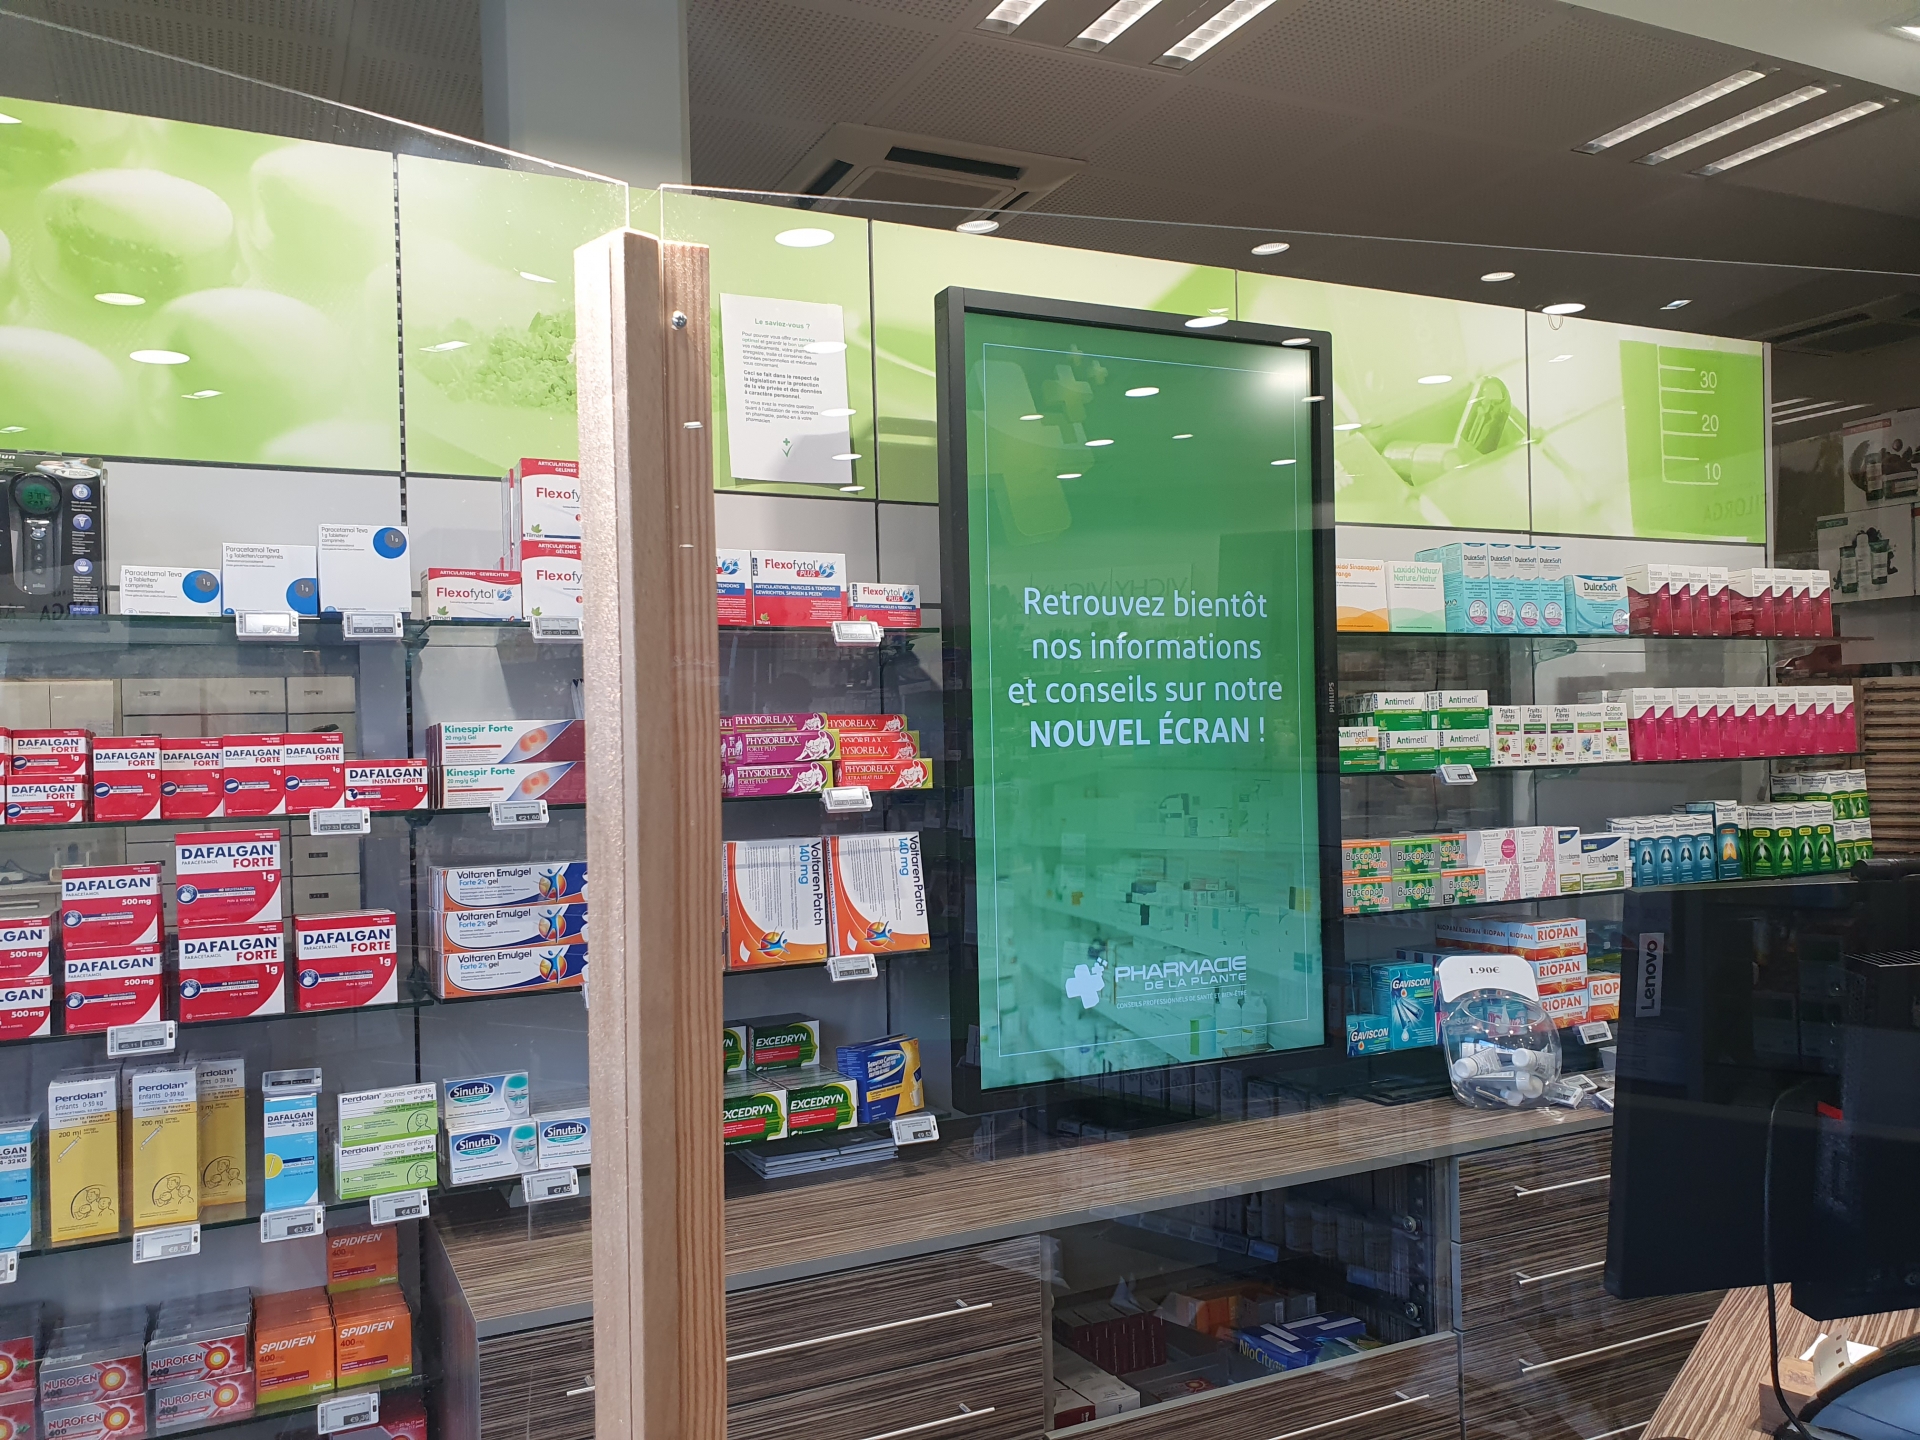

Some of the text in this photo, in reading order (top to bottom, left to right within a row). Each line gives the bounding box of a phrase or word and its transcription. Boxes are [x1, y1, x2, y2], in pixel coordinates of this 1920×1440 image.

[764, 320, 805, 330] saviez-vous
[1700, 371, 1717, 389] 30
[1702, 414, 1719, 432] 20
[1704, 463, 1721, 481] 10
[225, 546, 266, 554] Paracetamol
[765, 558, 816, 573] Flexofytol
[124, 569, 167, 578] Paracetamol
[862, 587, 900, 597] Flexofytol
[1584, 582, 1618, 592] DulceSoft
[436, 587, 494, 600] Flexofytol
[1024, 587, 1268, 618] Retrouvez bientôt
[1032, 631, 1262, 660] nos informations
[1008, 674, 1283, 704] et conseils sur notre
[1384, 697, 1415, 706] Antimetil
[1448, 694, 1478, 704] Antimetil
[736, 716, 794, 725] PHYSIORELAX
[444, 724, 514, 736] Kinespir Forte
[1030, 710, 1266, 748] NOUVEL ÉCRAN !
[18, 738, 79, 747] DAFALGAN
[746, 736, 800, 745] PHYSIORELAX
[1397, 736, 1428, 744] Antimetil
[1450, 734, 1480, 743] Antimetil
[95, 752, 156, 760] DAFALGAN
[225, 749, 280, 758] DAFALGAN
[128, 759, 156, 767] FORTE
[845, 764, 895, 774] PHYSIORELAX
[350, 768, 423, 778] DAFALGAN
[446, 768, 516, 780] Kinespir Forte
[738, 768, 792, 777] PHYSIORELAX
[181, 844, 274, 860] DAFALGAN
[898, 837, 908, 876] 140 mg
[1346, 852, 1382, 862] Buscopan
[1397, 852, 1435, 863] Buscopan
[234, 857, 274, 868] FORTE
[798, 844, 810, 884] 140 mg
[262, 872, 274, 882] 1g
[457, 868, 532, 880] Voltaren Emulgel
[909, 835, 926, 916] Voltaren Patch
[65, 877, 151, 892] DAFALGAN
[488, 878, 498, 887] gel
[810, 842, 824, 926] Voltaren Patch
[1449, 880, 1480, 890] Buscopan
[1346, 888, 1384, 900] Buscopan
[1398, 886, 1435, 899] Buscopan
[456, 908, 531, 920] Voltaren Emulgel
[1459, 926, 1481, 934] RIOPAN
[1484, 928, 1506, 938] RIOPAN
[1510, 932, 1533, 940] RIOPAN
[1538, 926, 1578, 941] RIOPAN
[304, 928, 390, 946] DAFALGAN
[184, 937, 278, 954] DAFALGAN
[351, 942, 390, 953] FORTE
[236, 950, 278, 962] FORTE
[458, 950, 532, 963] Voltaren Emulgel
[68, 957, 154, 974] DAFALGAN
[1115, 956, 1246, 982] PHARMACIE
[1468, 966, 1500, 974] 1.90€
[1539, 962, 1580, 977] RIOPAN
[1641, 940, 1658, 1010] Lenovo
[141, 978, 154, 986] mg
[1144, 973, 1246, 990] DE LA PLANTE
[1392, 978, 1431, 989] GAVISCON
[1116, 1000, 1142, 1009] CONSEILS
[1143, 996, 1188, 1006] PROFESSIONNELS
[1196, 992, 1214, 1001] SANTÉ
[1222, 990, 1247, 998] BIEN-ÊTRE
[1542, 996, 1582, 1012] RIOPAN
[756, 1033, 807, 1048] EXCEDRYN
[1351, 1028, 1388, 1042] GAVISCON
[138, 1082, 184, 1092] Perdolan
[454, 1084, 490, 1098] Sinutab
[55, 1091, 104, 1103] Perdolan
[138, 1092, 162, 1100] Enfants
[342, 1086, 432, 1104] Perdolan Jeunes enfants
[790, 1094, 844, 1110] EXCEDRYN
[268, 1111, 314, 1122] DAFALGAN
[548, 1124, 583, 1137] Sinutab
[342, 1138, 432, 1156] Perdolan Jeunes enfants
[460, 1136, 497, 1150] Sinutab
[332, 1233, 382, 1248] SPIDIFEN
[340, 1320, 394, 1338] SPIDIFEN
[260, 1335, 316, 1354] SPIDIFEN
[340, 1338, 356, 1346] 400
[150, 1352, 204, 1370] NUROFEN
[44, 1374, 98, 1391] NUROFEN
[160, 1390, 212, 1408] NUROFEN
[48, 1412, 102, 1430] NUROFEN
